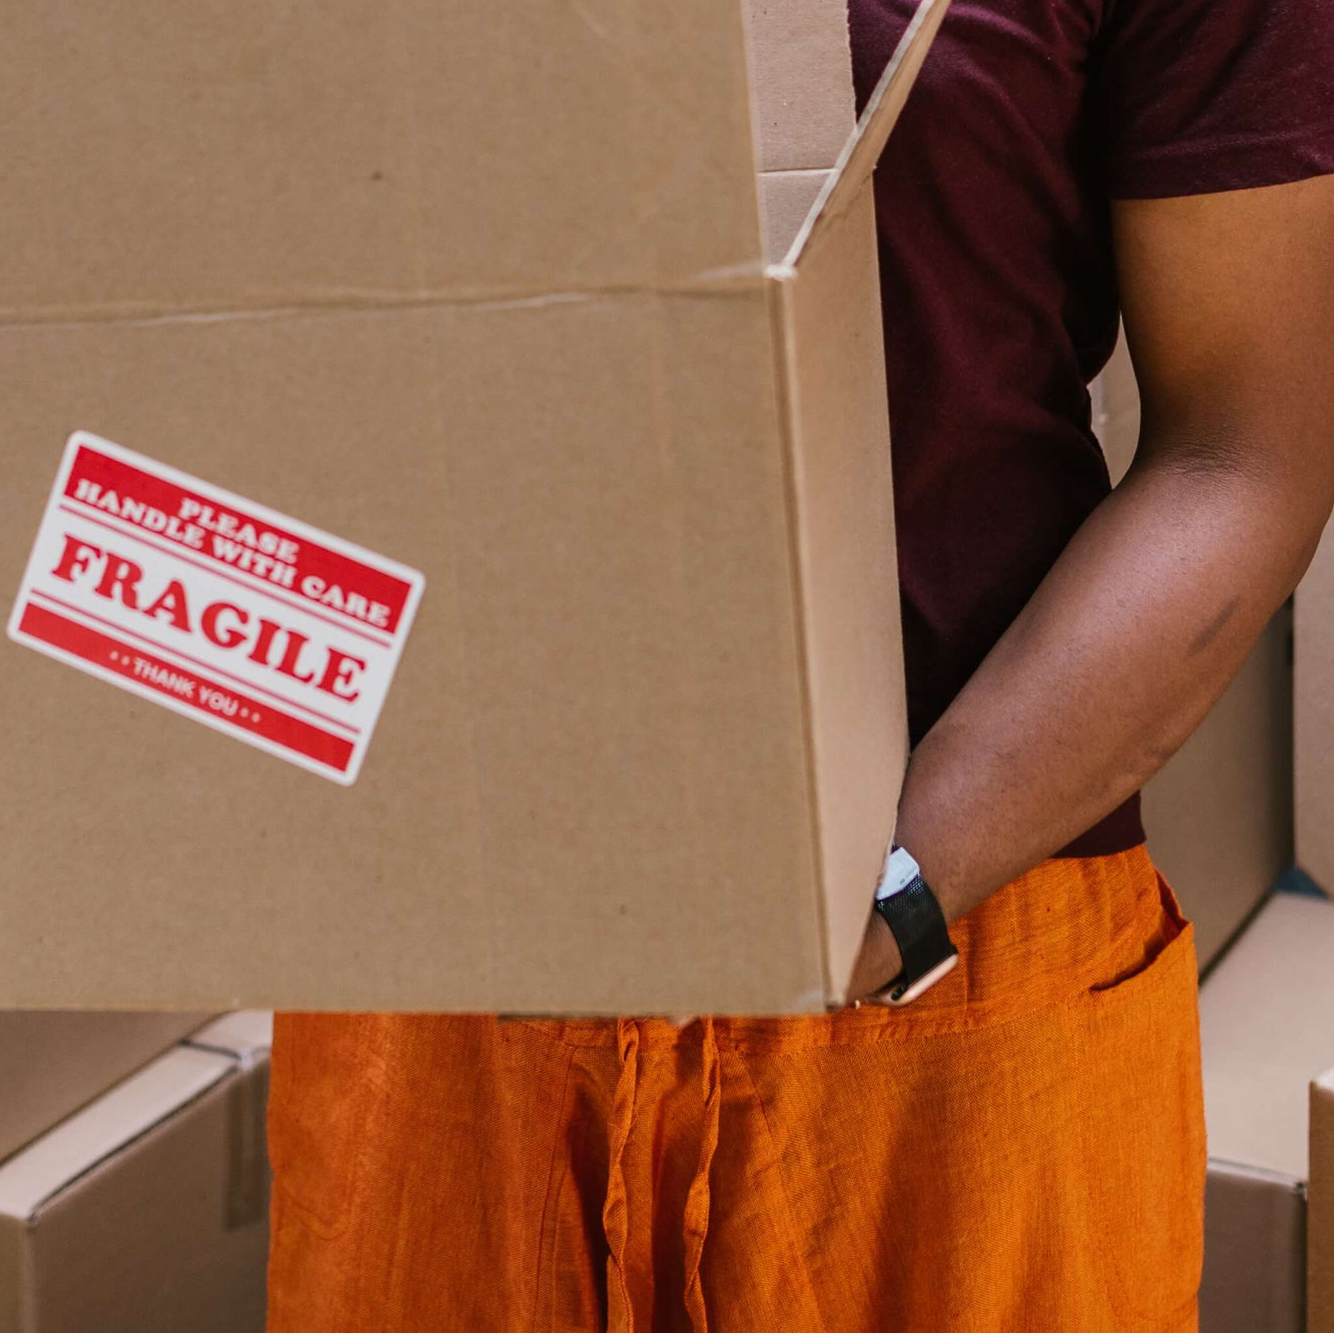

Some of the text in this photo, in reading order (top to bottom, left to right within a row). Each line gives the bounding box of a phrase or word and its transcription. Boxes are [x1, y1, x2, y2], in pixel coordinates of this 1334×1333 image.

[74, 479, 391, 628] HANDLE WITH CARE
[180, 498, 300, 564] PLEASE
[51, 534, 369, 703] FRAGILE
[134, 657, 239, 716] THANK YOU
